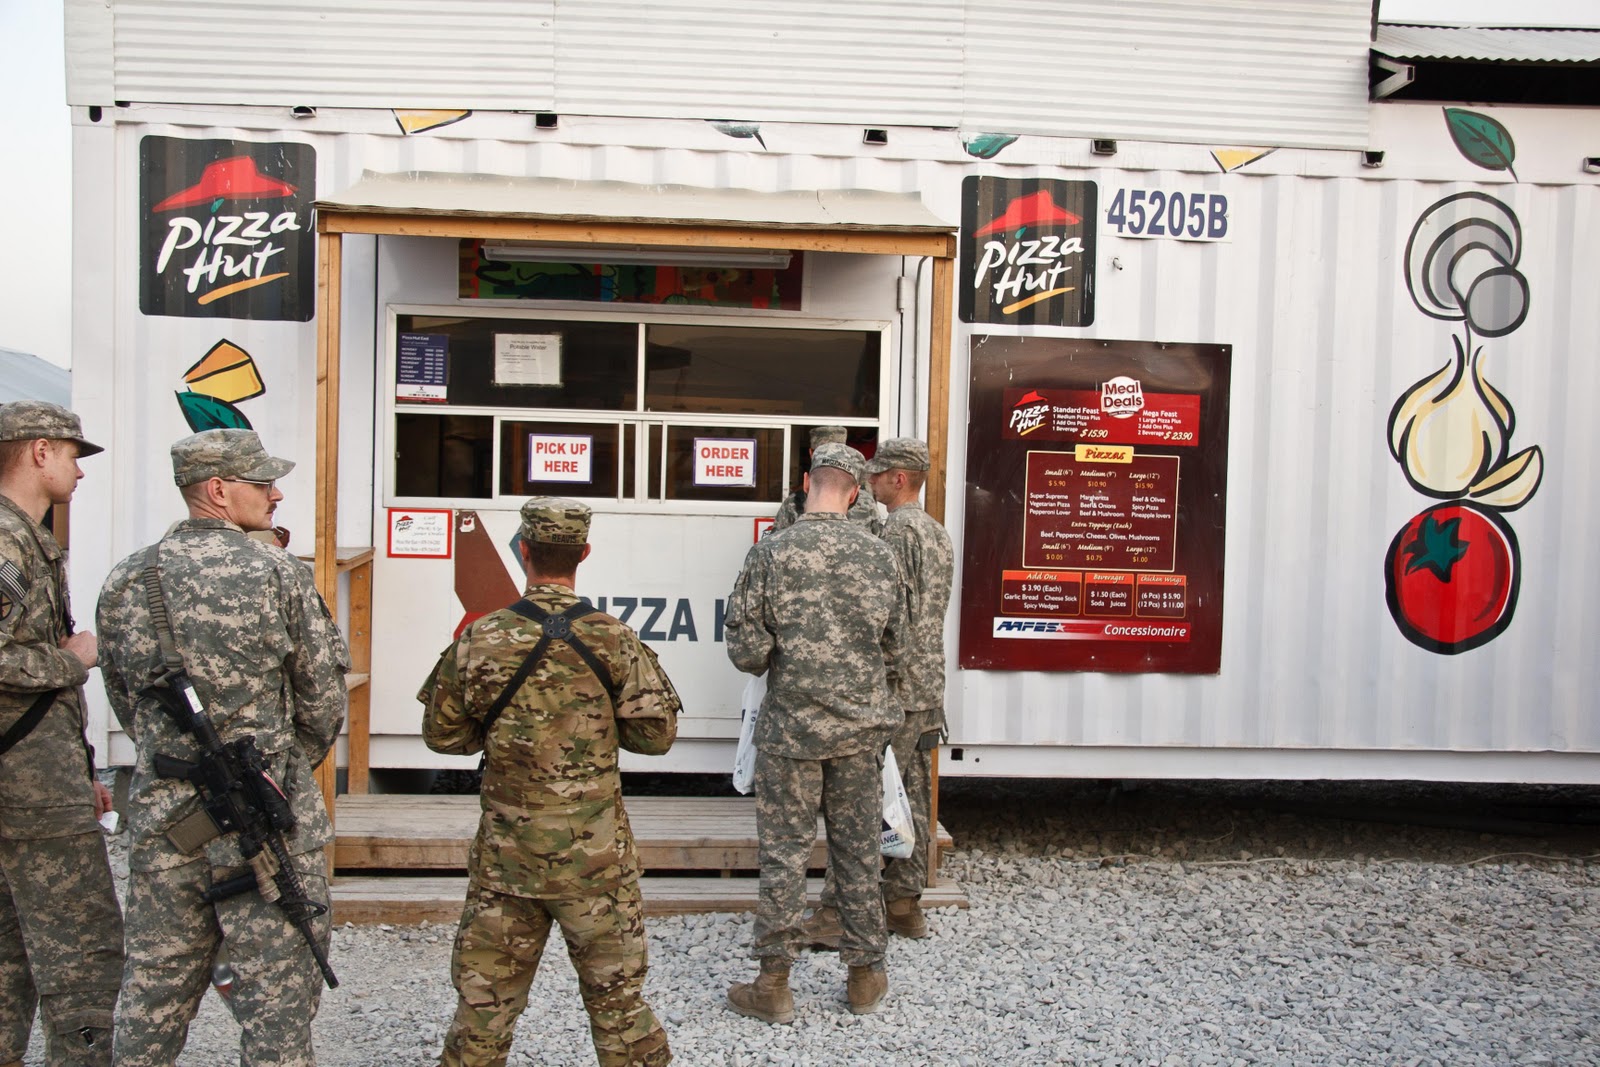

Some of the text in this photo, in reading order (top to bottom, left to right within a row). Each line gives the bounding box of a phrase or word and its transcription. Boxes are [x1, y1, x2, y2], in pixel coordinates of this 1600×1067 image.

[1107, 188, 1228, 239] 45205B
[157, 199, 301, 274] Pizza
[974, 227, 1085, 289] Pizza
[183, 242, 285, 293] Hut
[993, 261, 1072, 304] Hut
[1105, 382, 1139, 395] Meal
[1104, 395, 1142, 408] Deals
[1009, 405, 1050, 428] Pizza
[1017, 414, 1045, 433] Hut
[1080, 429, 1088, 437] $
[1164, 431, 1172, 440] $
[536, 442, 587, 455] PICK UP
[701, 447, 750, 460] ORDER
[1085, 447, 1126, 460] Pizzas
[544, 460, 578, 473] HERE
[705, 464, 744, 477] HERE
[1129, 473, 1146, 481] Large
[1089, 522, 1112, 530] Toppings
[552, 533, 577, 543] REAVIS
[1126, 546, 1143, 555] Large
[1093, 574, 1124, 583] Beverages
[1164, 576, 1182, 585] Wings
[578, 596, 698, 642] ZZA
[996, 621, 1186, 637] AAFES Concessionaire
